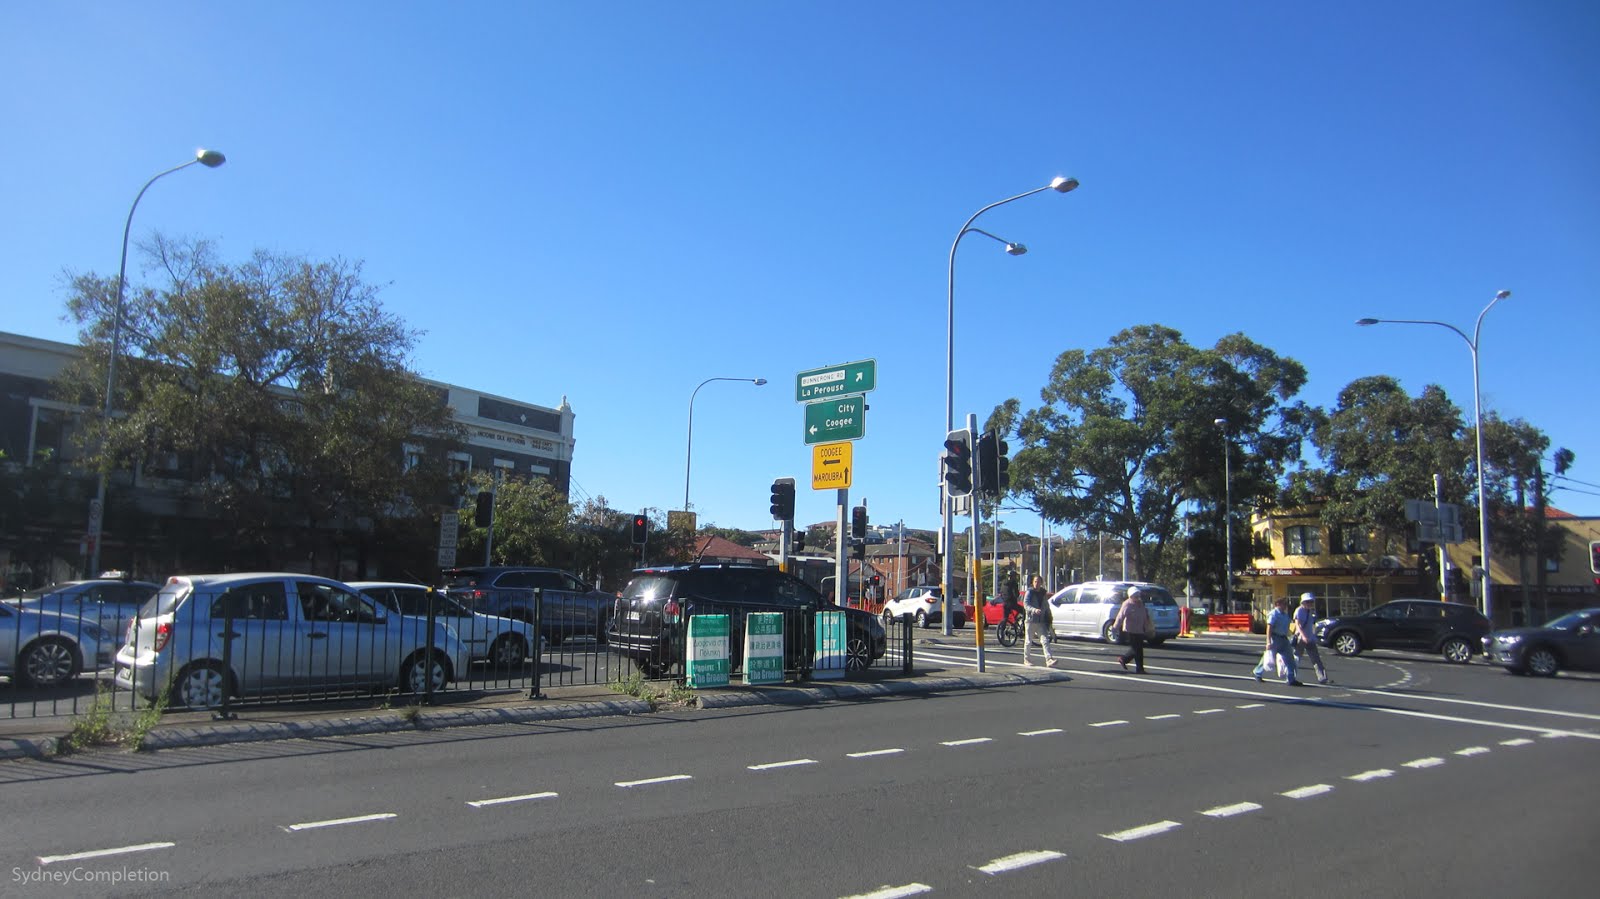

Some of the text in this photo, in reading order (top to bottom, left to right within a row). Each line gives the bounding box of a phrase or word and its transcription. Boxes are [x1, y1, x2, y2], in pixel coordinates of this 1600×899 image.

[803, 371, 844, 385] BUNNERONG RD
[801, 383, 844, 397] La Perouse
[838, 404, 855, 413] City
[825, 417, 853, 428] Coogee
[820, 446, 842, 458] COOGEE
[813, 471, 843, 482] MAROUBRA
[693, 672, 728, 685] The Greens
[750, 669, 782, 680] The Greens
